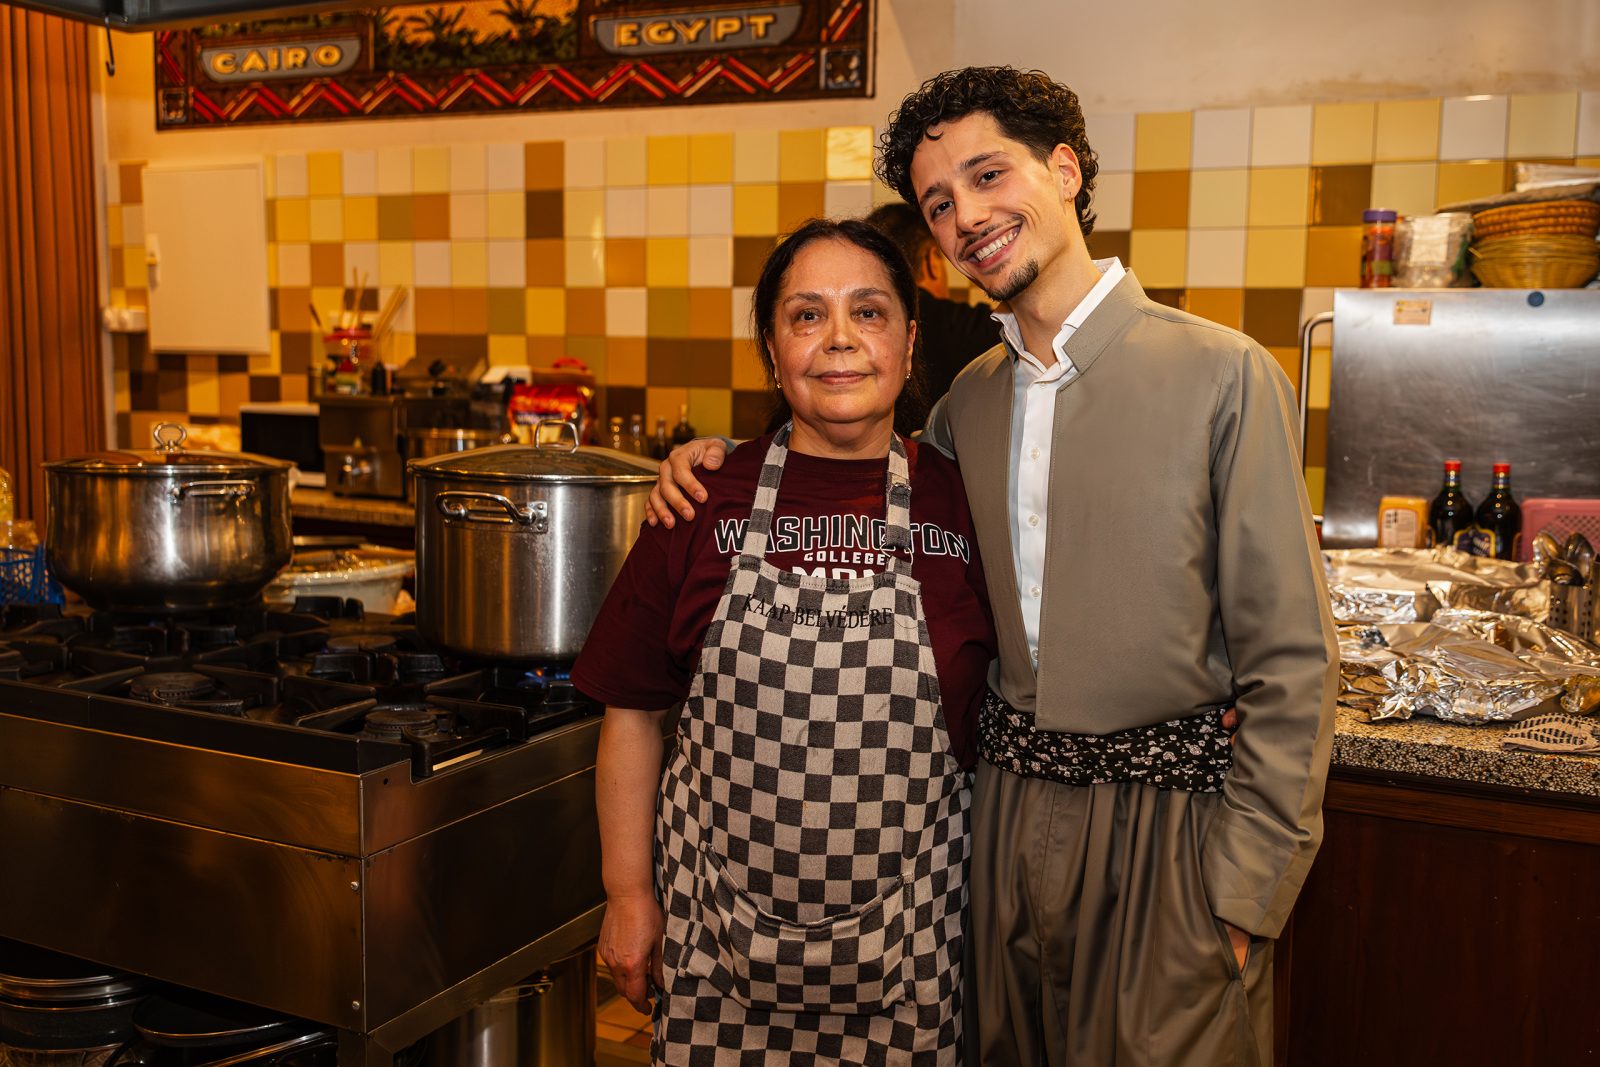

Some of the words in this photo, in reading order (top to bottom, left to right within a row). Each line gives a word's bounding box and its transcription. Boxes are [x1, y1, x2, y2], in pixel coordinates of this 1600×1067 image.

[614, 14, 775, 48] EGYPT
[211, 45, 342, 74] CAIRO
[714, 514, 970, 564] WSHINGON
[803, 551, 886, 565] COLLEGE
[741, 593, 791, 622] KAAP
